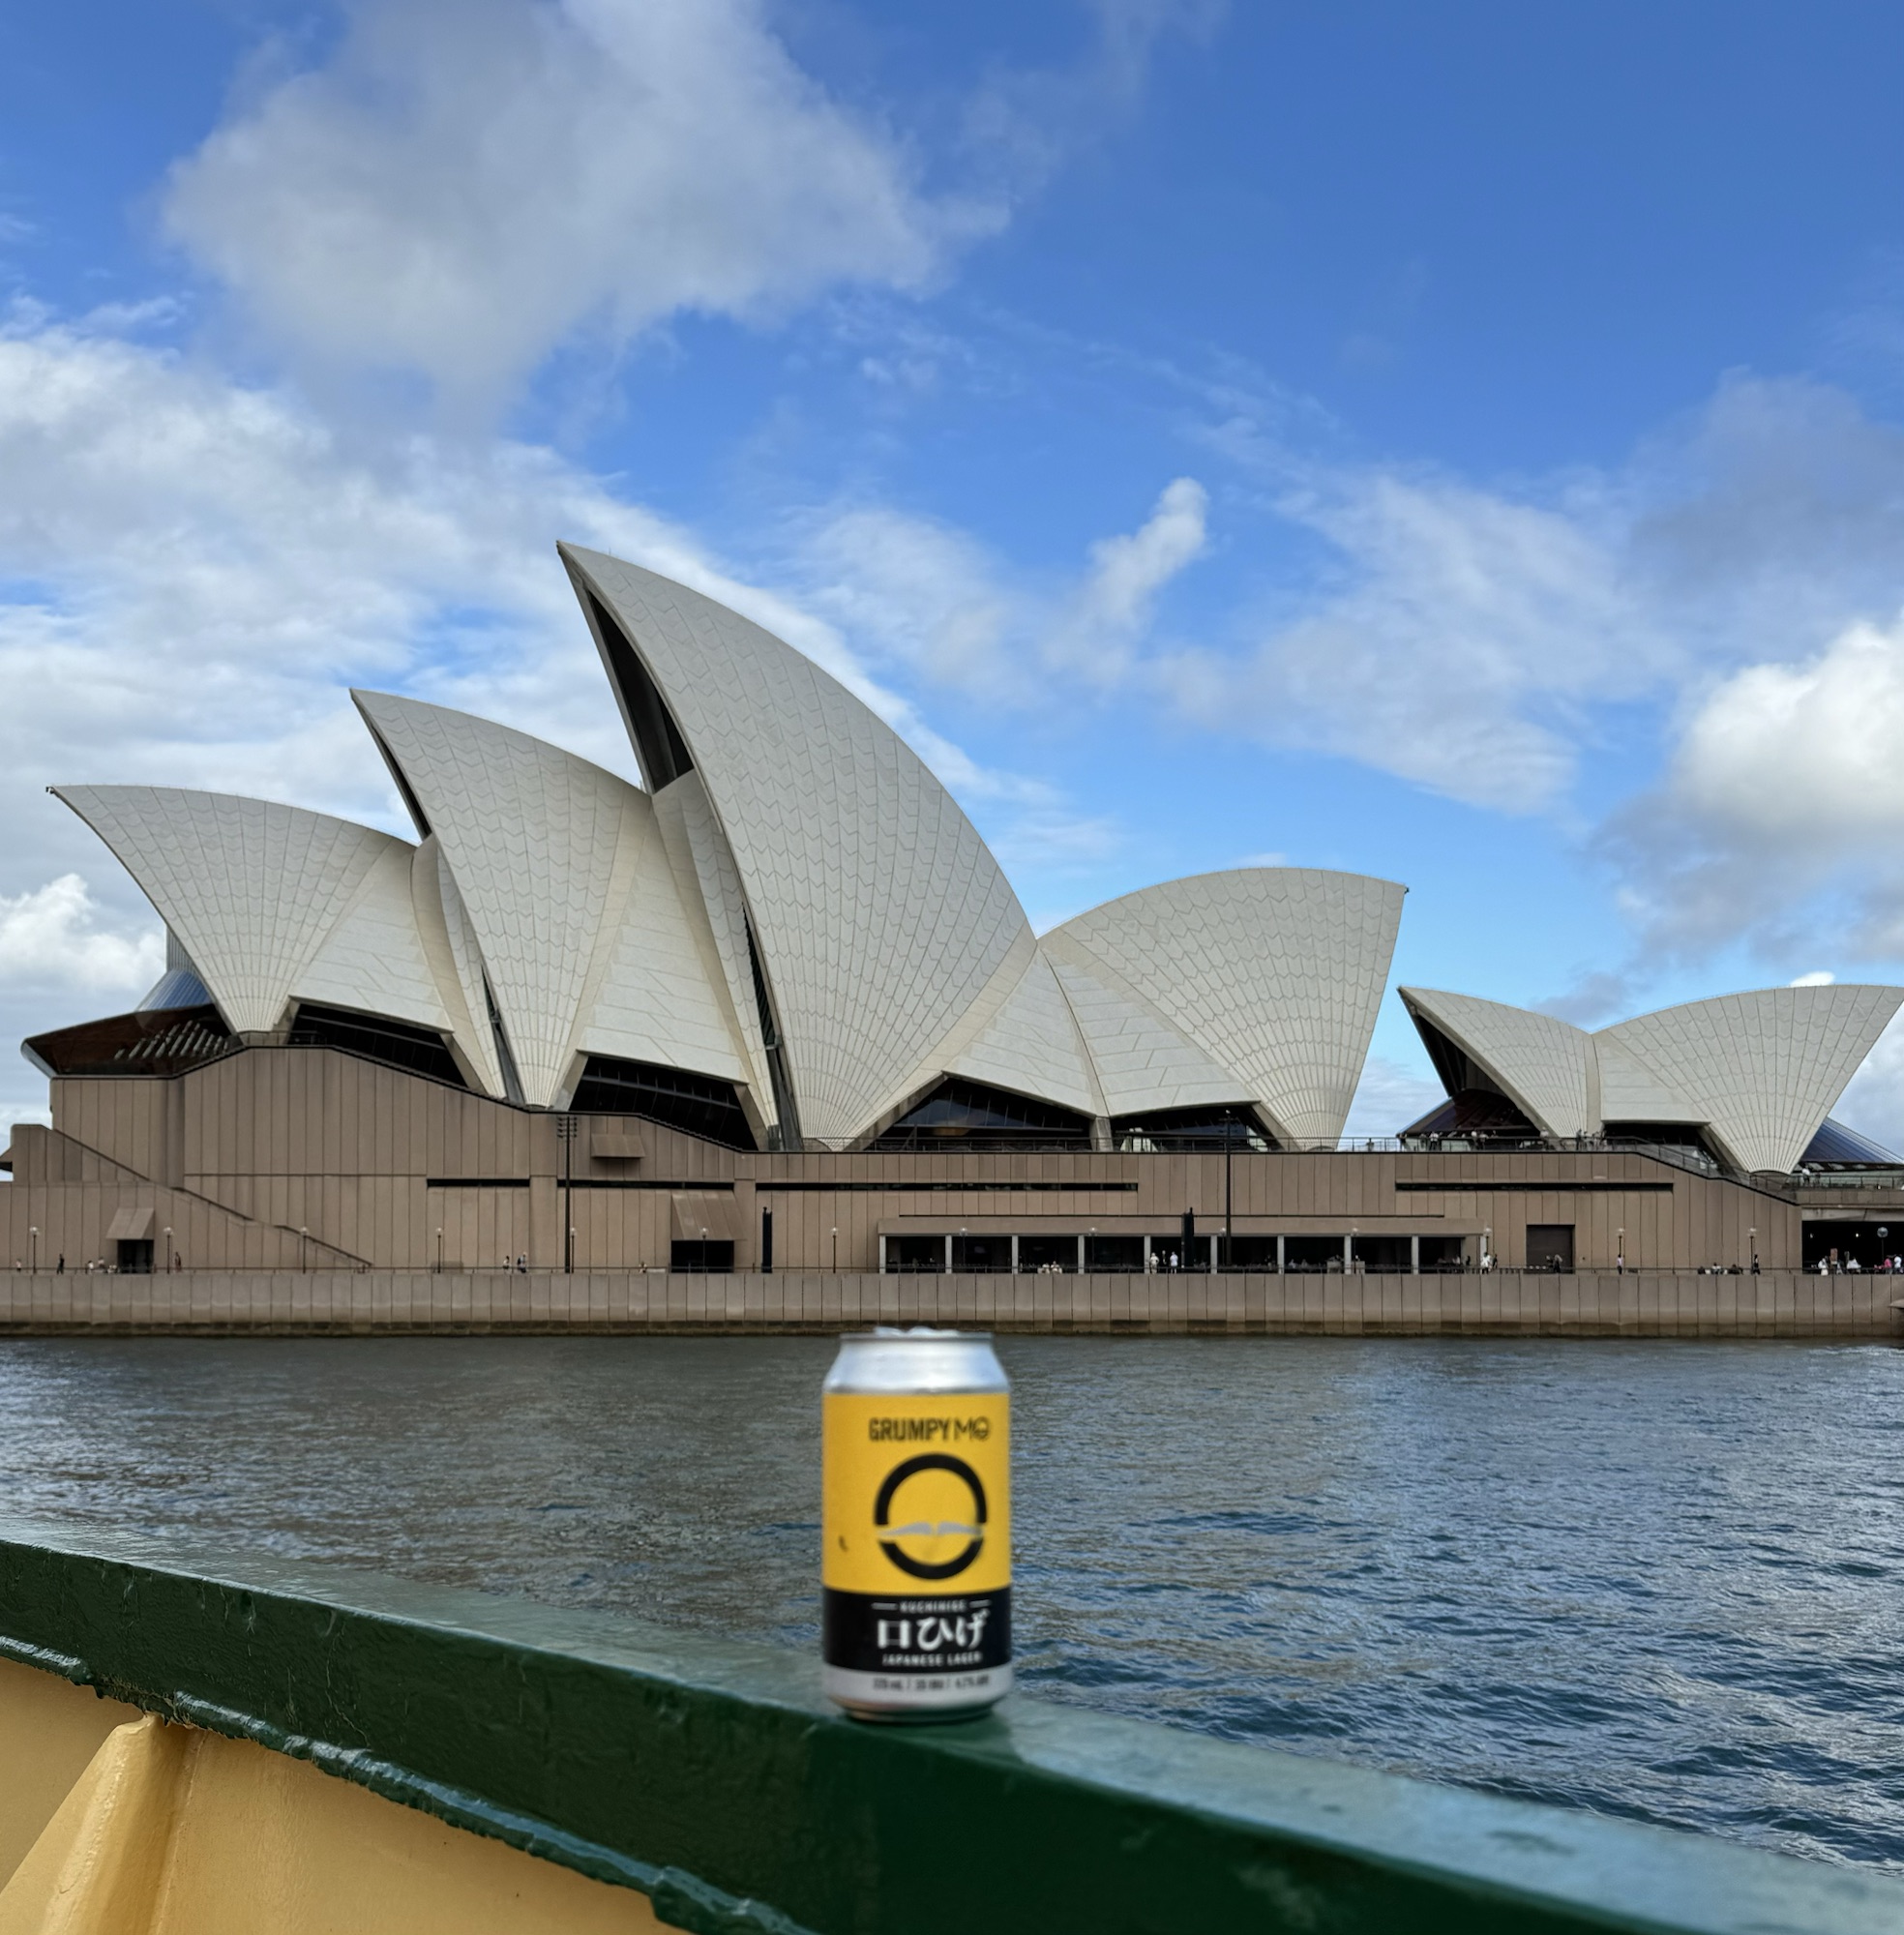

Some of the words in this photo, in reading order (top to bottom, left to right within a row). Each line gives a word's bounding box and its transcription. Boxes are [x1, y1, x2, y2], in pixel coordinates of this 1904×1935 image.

[869, 1417, 950, 1441] GRUMPY
[877, 1608, 990, 1651] 口ひげ
[882, 1652, 944, 1666] JAPANESE
[946, 1651, 983, 1665] LAGER
